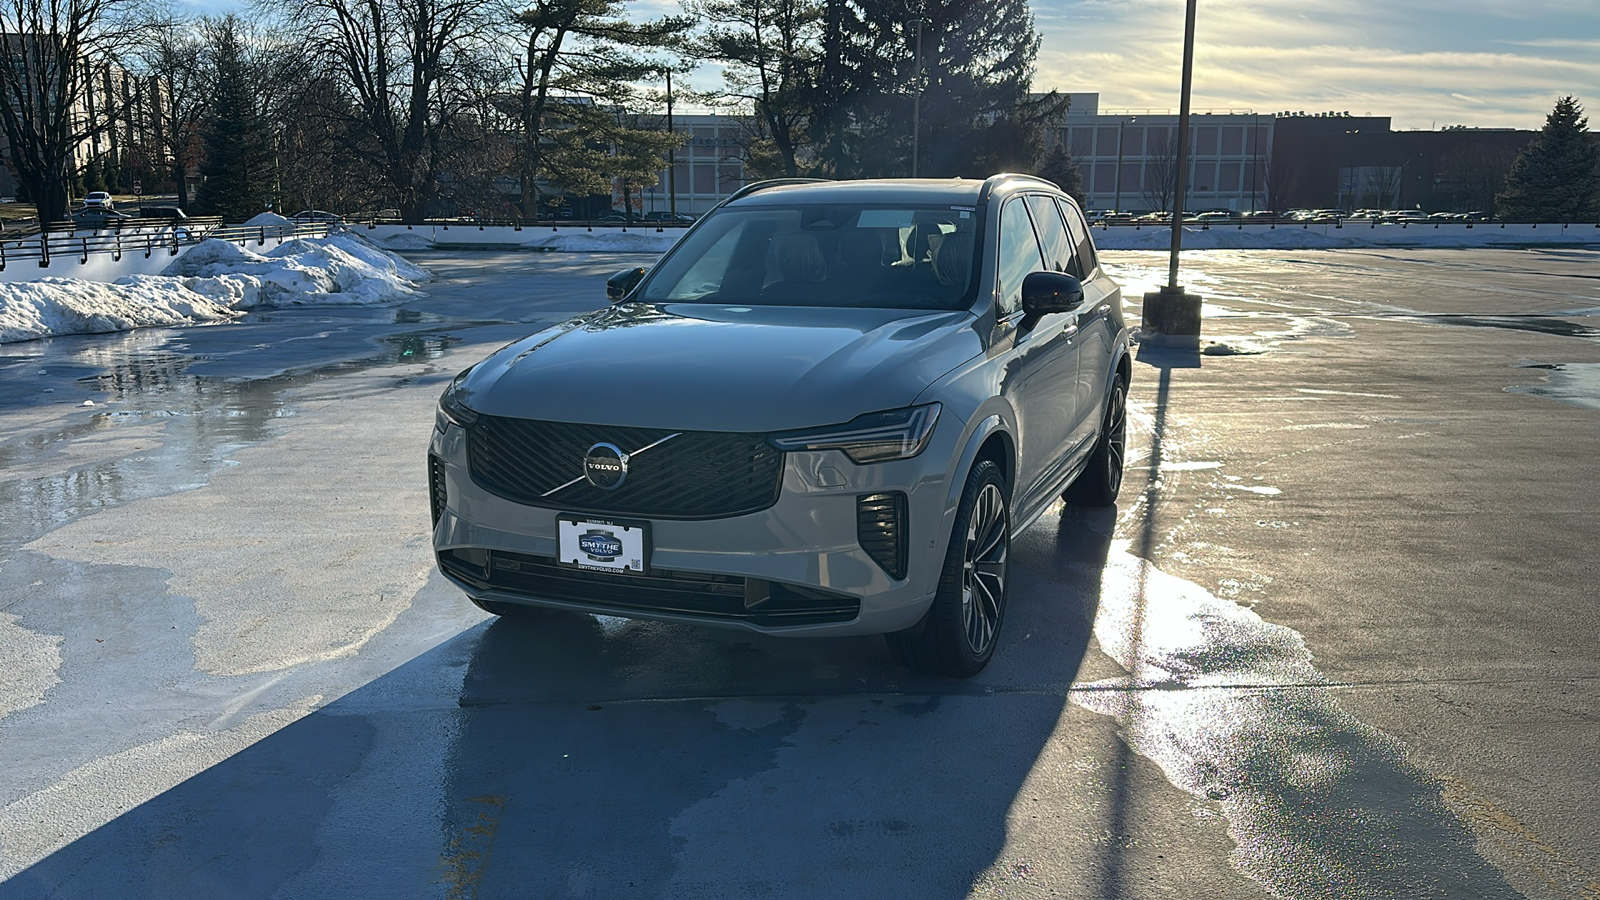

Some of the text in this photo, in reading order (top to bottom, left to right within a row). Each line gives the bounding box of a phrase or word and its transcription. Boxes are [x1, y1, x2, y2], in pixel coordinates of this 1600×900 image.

[588, 463, 620, 471] VOLVO
[581, 541, 619, 551] SMYTHE
[578, 564, 624, 574] SMYTHEVOLVO.COM
